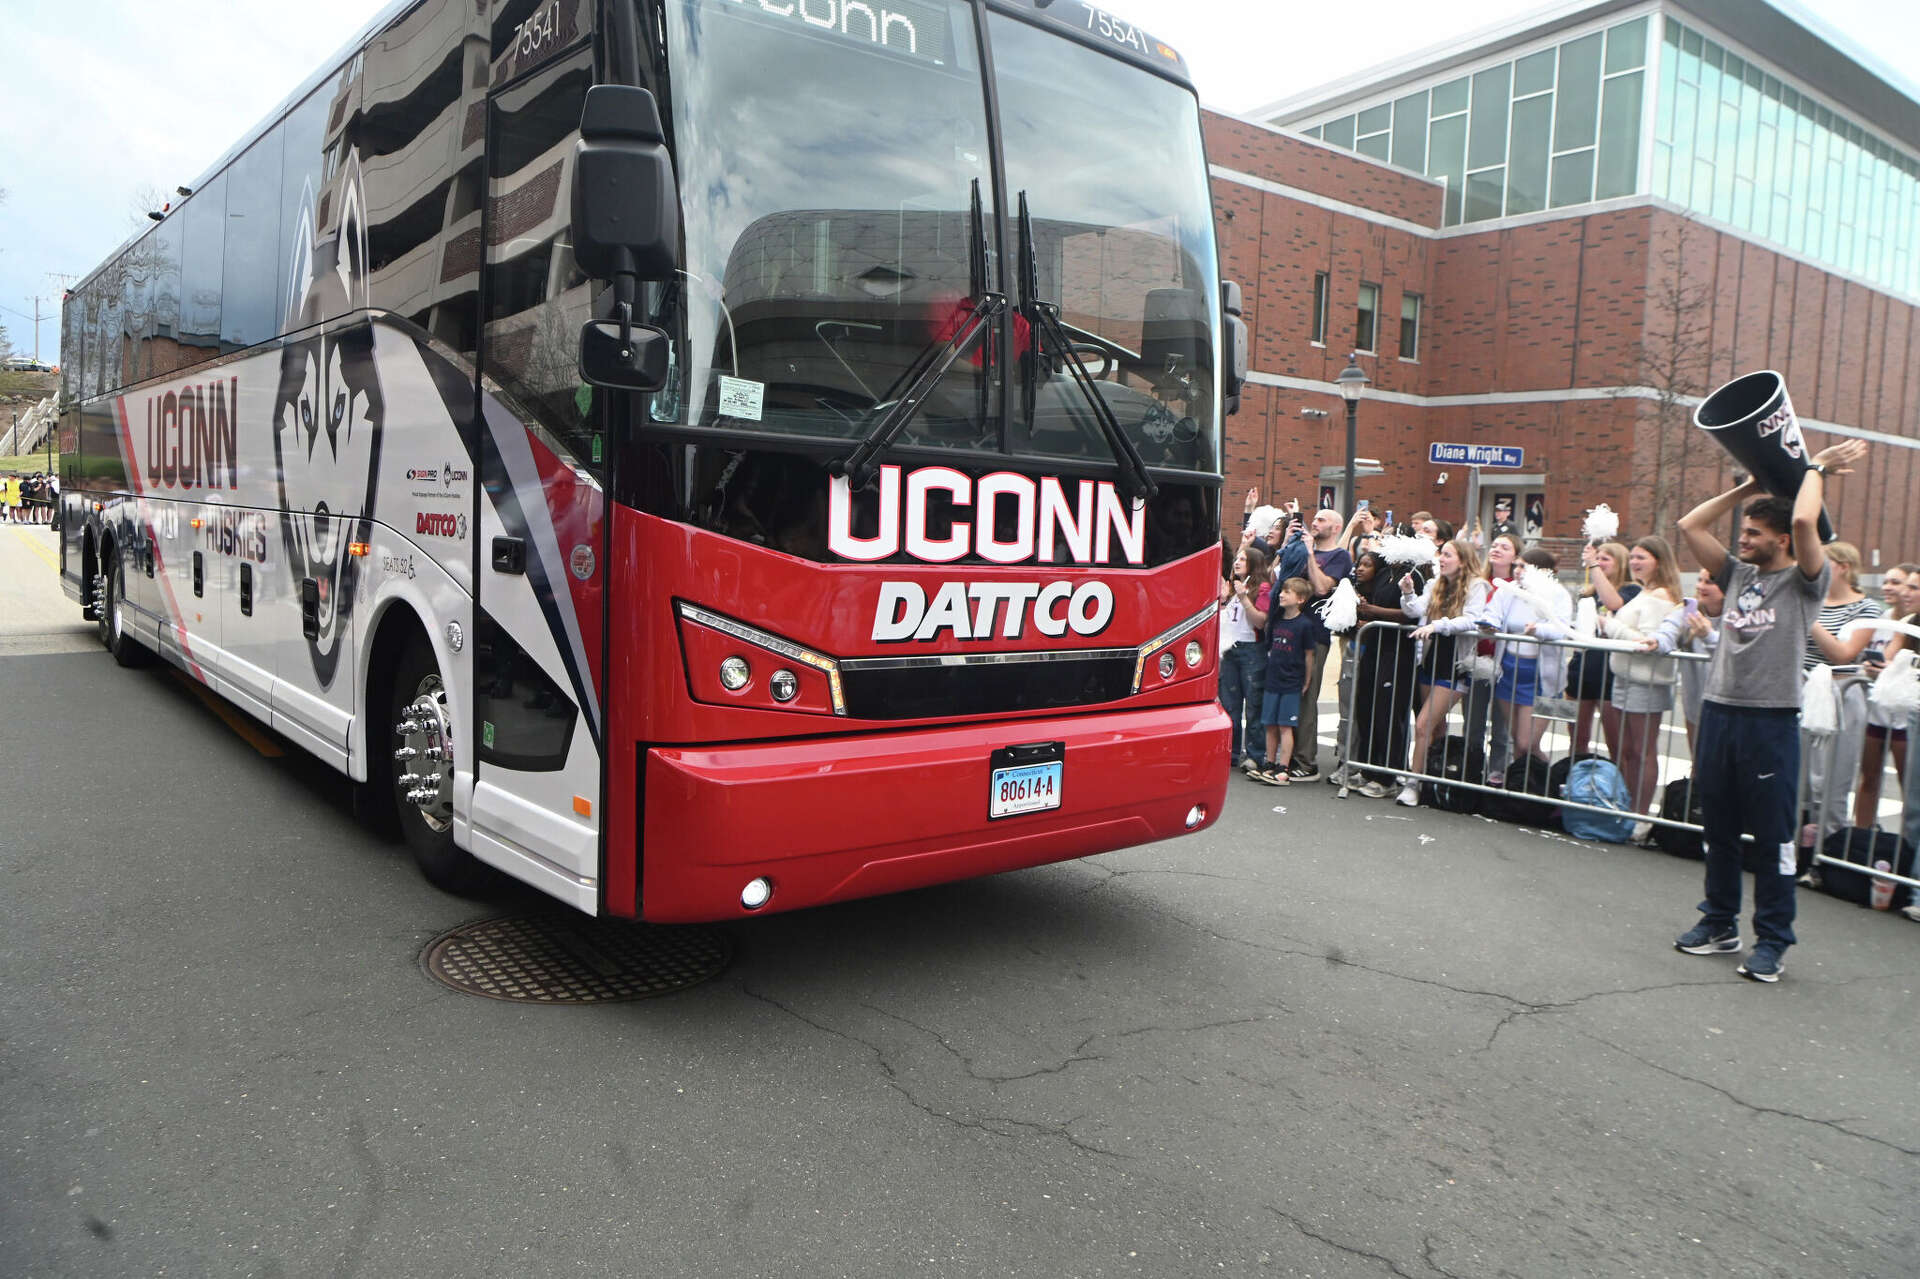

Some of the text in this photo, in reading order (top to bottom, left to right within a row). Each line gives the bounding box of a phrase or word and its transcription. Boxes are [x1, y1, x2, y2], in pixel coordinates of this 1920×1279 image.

[513, 1, 560, 63] 75541
[738, 0, 916, 53] onn
[1081, 3, 1149, 54] 75541
[147, 376, 238, 490] UCONN
[1435, 444, 1466, 460] Diane
[1467, 445, 1503, 465] Wright
[206, 508, 267, 564] HUSKIES
[416, 512, 457, 537] DATTCO
[828, 464, 1147, 564] UCONN
[871, 580, 1115, 642] DATTCO
